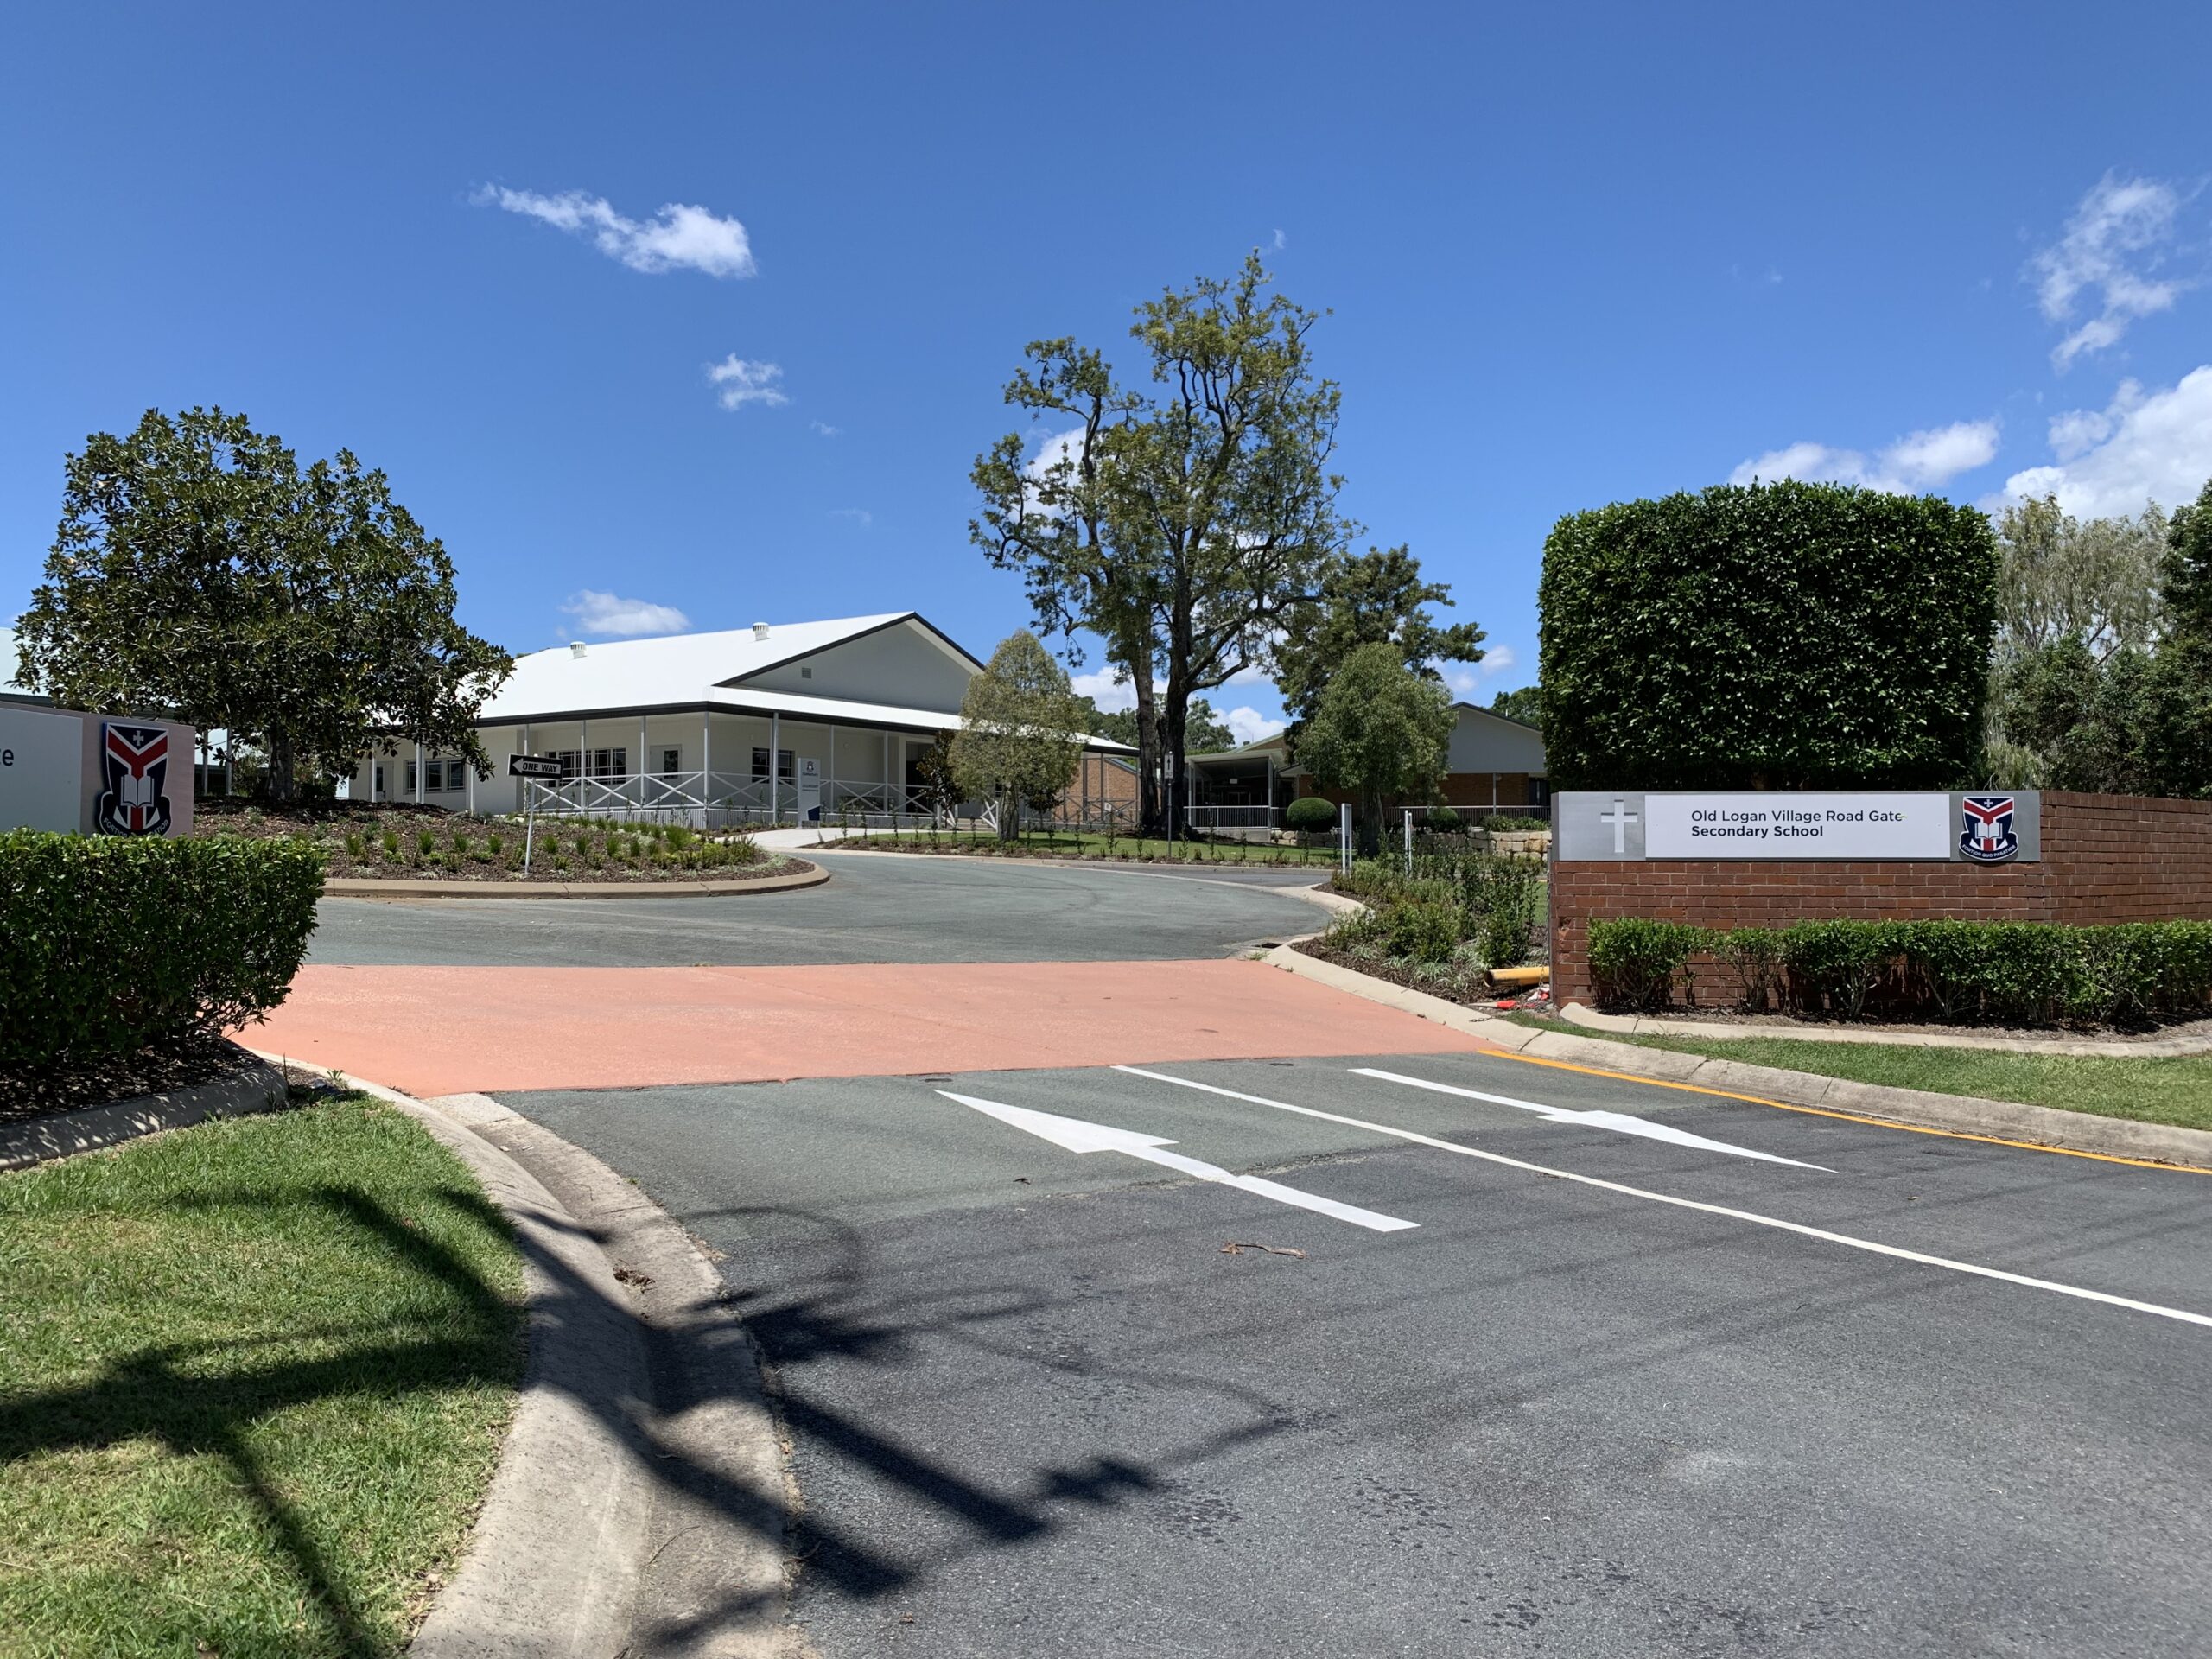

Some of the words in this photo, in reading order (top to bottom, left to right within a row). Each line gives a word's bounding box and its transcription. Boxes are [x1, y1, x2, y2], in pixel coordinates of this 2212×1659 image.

[0, 749, 14, 767] e
[523, 762, 539, 772] ONE
[541, 764, 558, 772] WAY
[1691, 810, 1717, 822] Old
[1722, 810, 1767, 823] Logan
[1771, 810, 1821, 823] Village
[1826, 810, 1864, 822] Road
[1868, 810, 1903, 822] Gate
[1691, 825, 1769, 839] Secondary
[1774, 825, 1823, 836] School
